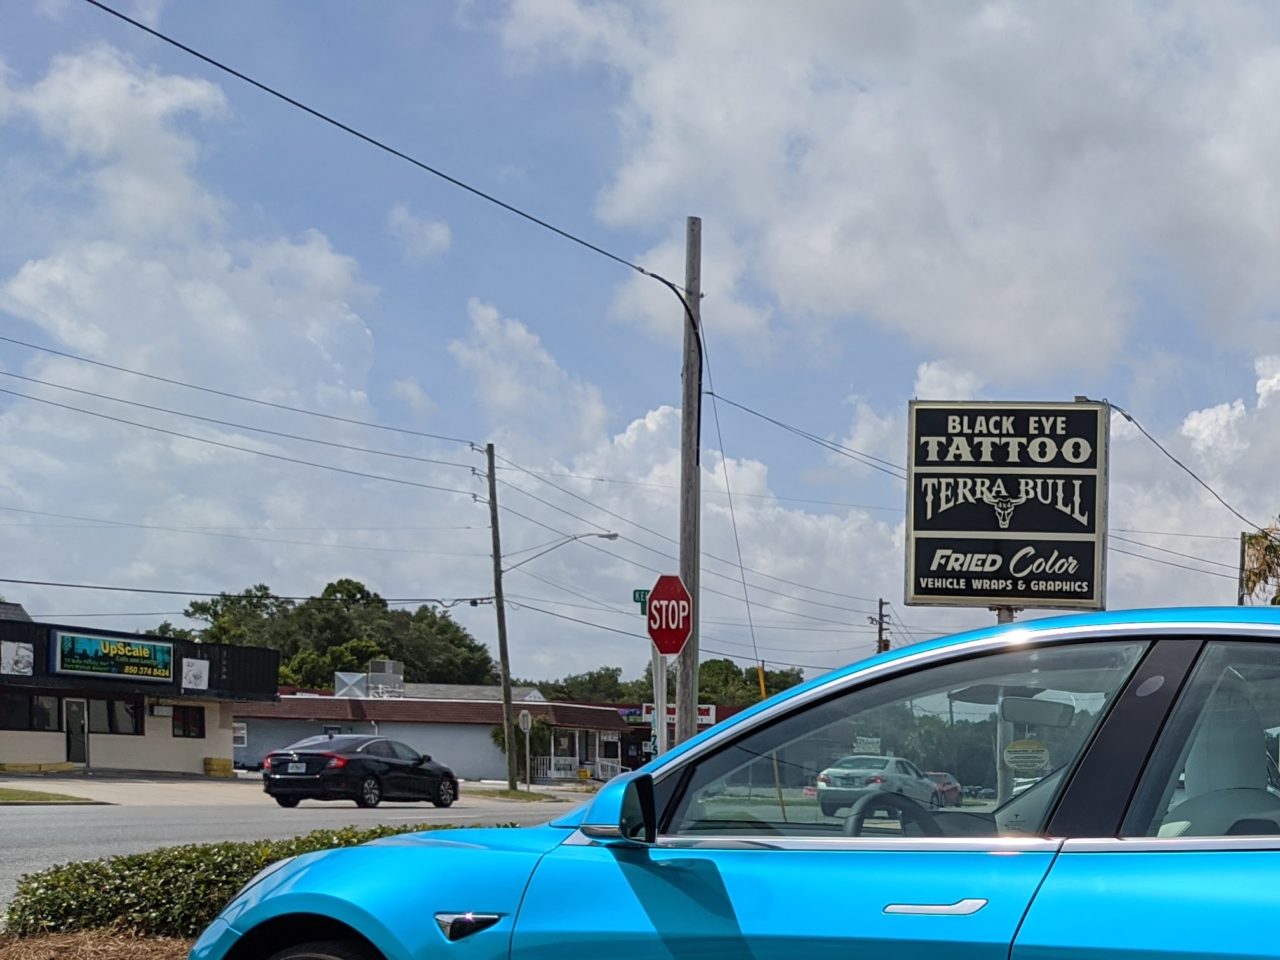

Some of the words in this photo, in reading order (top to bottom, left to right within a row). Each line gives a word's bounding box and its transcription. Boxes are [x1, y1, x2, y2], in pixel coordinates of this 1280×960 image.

[947, 415, 1015, 434] BLACK
[1029, 416, 1066, 435] EYE
[920, 436, 1092, 463] TATTOO
[921, 478, 1009, 520] TERRA
[1018, 478, 1089, 527] BULL
[930, 549, 1003, 572] FRIED
[1009, 546, 1080, 578] Color
[920, 577, 966, 589] VEHICLE
[972, 579, 1012, 590] WRAPS
[1017, 580, 1026, 591] &
[1030, 580, 1089, 592] GRAPHICS
[650, 600, 689, 629] STOP
[101, 640, 150, 658] UpScale
[124, 665, 138, 674] 850
[138, 667, 152, 676] 374
